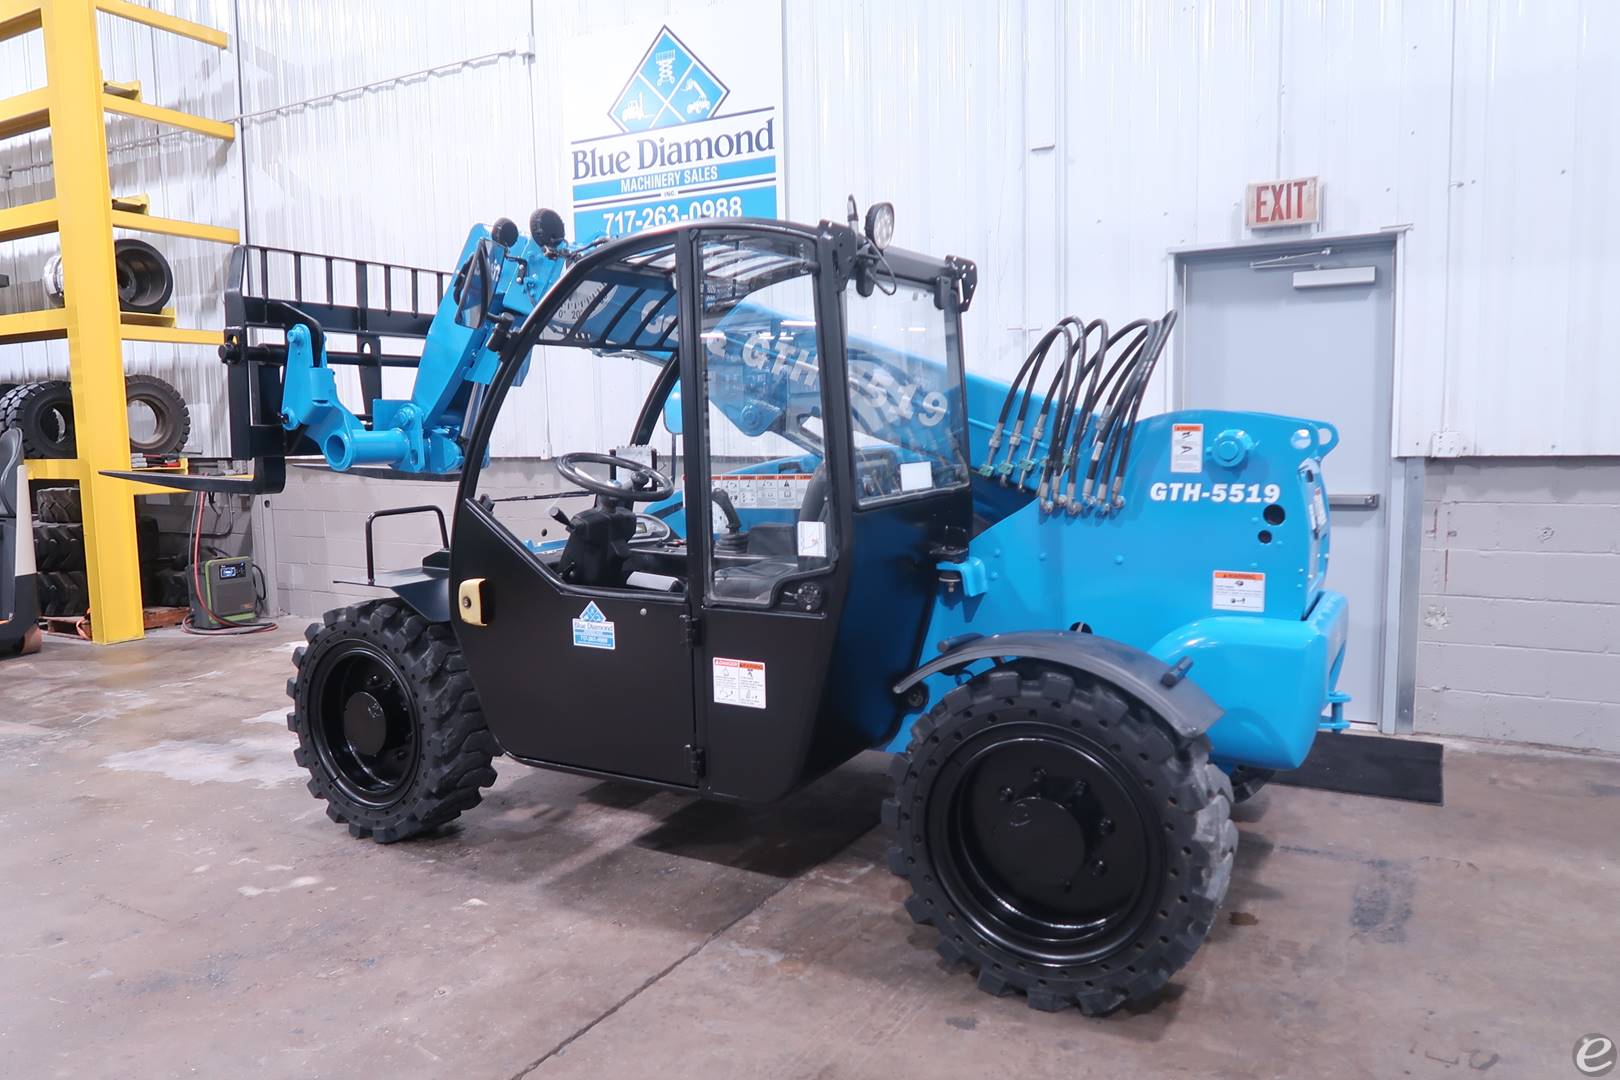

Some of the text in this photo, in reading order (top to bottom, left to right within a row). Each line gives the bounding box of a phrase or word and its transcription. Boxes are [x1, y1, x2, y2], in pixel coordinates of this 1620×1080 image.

[572, 117, 775, 180] Blue Diamond
[621, 166, 718, 193] MACHINERY SALES
[603, 196, 743, 235] 717-263-0988
[1256, 181, 1307, 223] EXIT
[1150, 482, 1281, 503] GTH-5519
